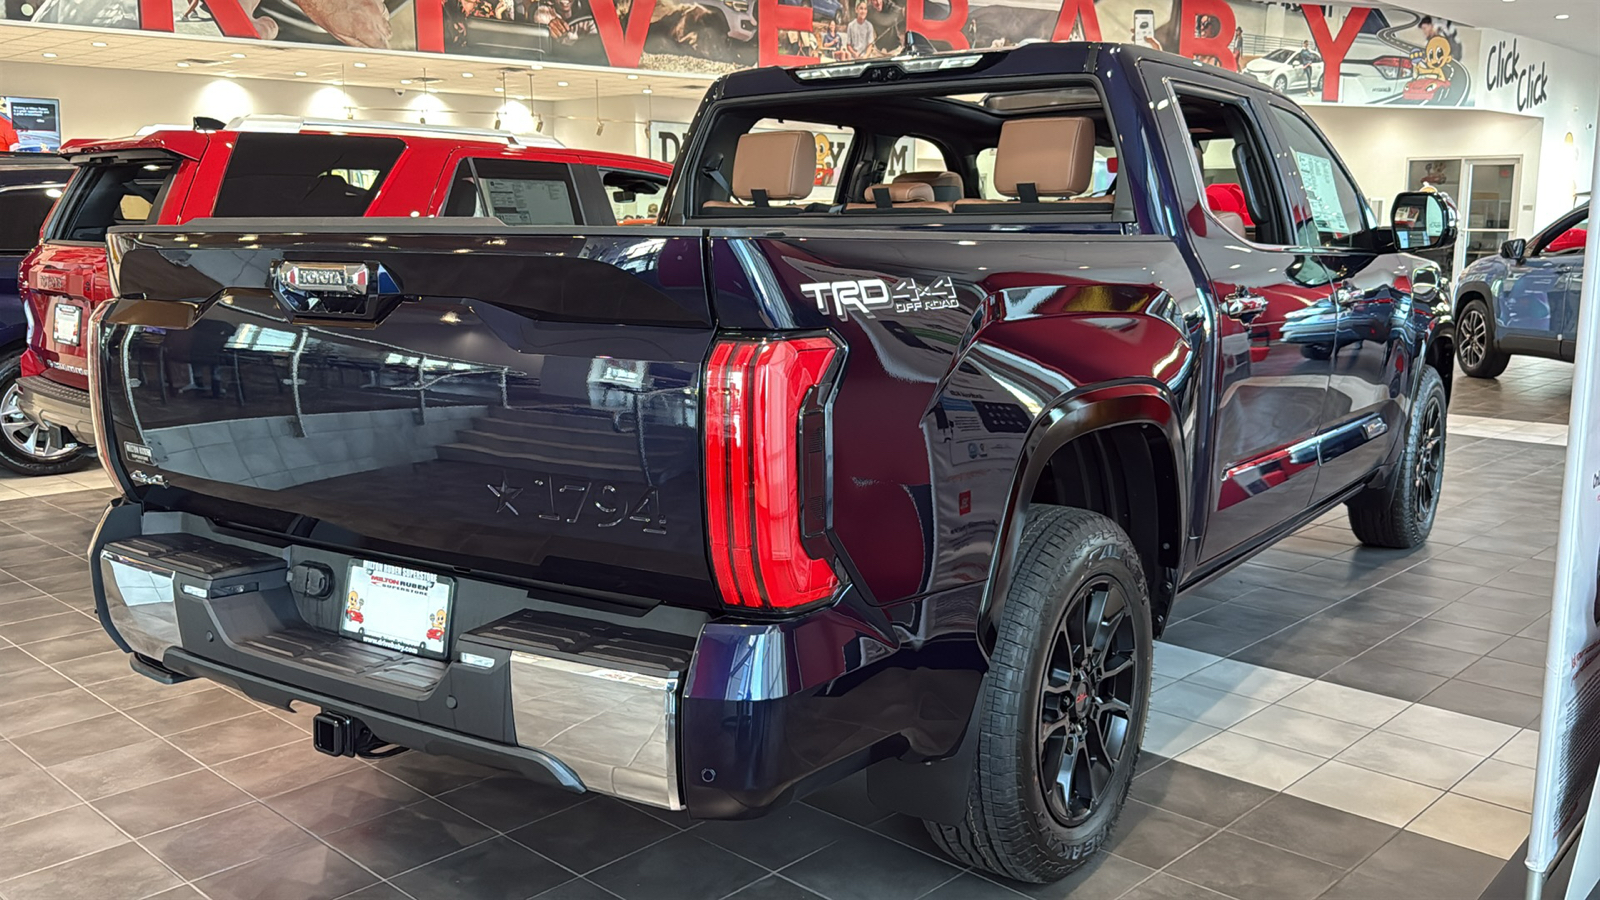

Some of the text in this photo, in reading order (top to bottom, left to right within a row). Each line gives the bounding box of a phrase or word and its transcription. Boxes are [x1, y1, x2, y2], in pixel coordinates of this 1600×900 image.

[1486, 37, 1520, 91] Click
[1517, 61, 1548, 112] Click
[300, 269, 343, 285] TOYOTA
[800, 278, 893, 321] TRD
[895, 299, 960, 314] OFF ROAD
[534, 475, 667, 535] 1794
[370, 574, 429, 591] MILTON RUBEN
[382, 583, 428, 596] SUPERSTORE
